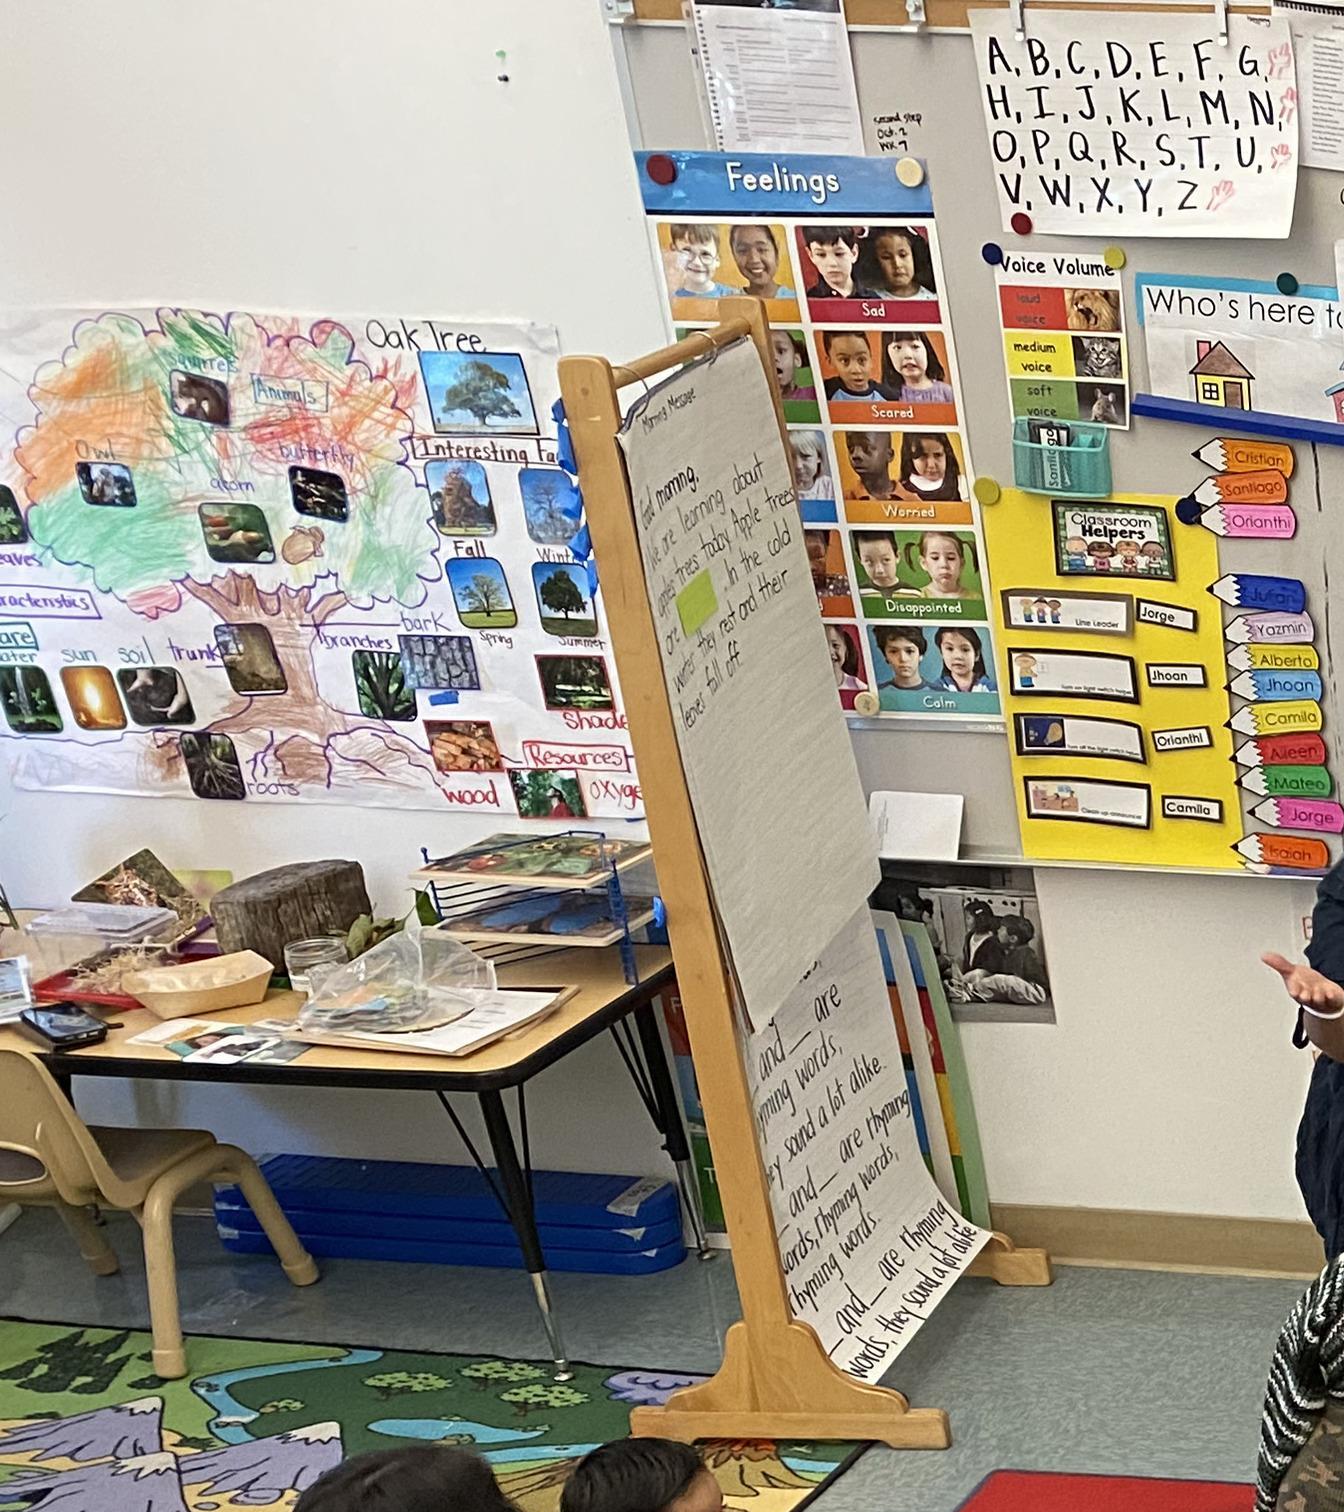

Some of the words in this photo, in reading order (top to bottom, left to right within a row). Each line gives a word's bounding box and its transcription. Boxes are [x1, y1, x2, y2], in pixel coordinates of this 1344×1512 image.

[725, 162, 840, 204] Feelings
[861, 303, 886, 318] Sad
[1146, 288, 1239, 318] Who's
[1249, 294, 1314, 325] here
[366, 319, 421, 350] Oak
[422, 321, 487, 352] Tree
[1027, 384, 1054, 397] soft
[871, 406, 914, 420] Scared
[421, 438, 528, 468] Interesting
[1234, 450, 1285, 467] Cristian
[732, 453, 764, 496] about
[882, 505, 935, 519] Worried
[1070, 512, 1152, 529] Classroom
[1081, 525, 1146, 540] Helpers
[454, 540, 486, 559] Fall
[885, 600, 962, 615] Disappointed
[1141, 606, 1175, 624] Jorge
[1260, 653, 1312, 668] Alberto
[1152, 671, 1188, 683] Jhoan
[923, 696, 956, 709] Calm
[1265, 709, 1318, 726] Camila
[247, 780, 299, 797] roots
[440, 779, 500, 807] wood
[867, 1089, 910, 1147] rhyming
[783, 1114, 817, 1162] sound
[903, 1200, 959, 1252] rhyming
[789, 1253, 843, 1316] rhyming
[905, 1269, 935, 1310] sound
